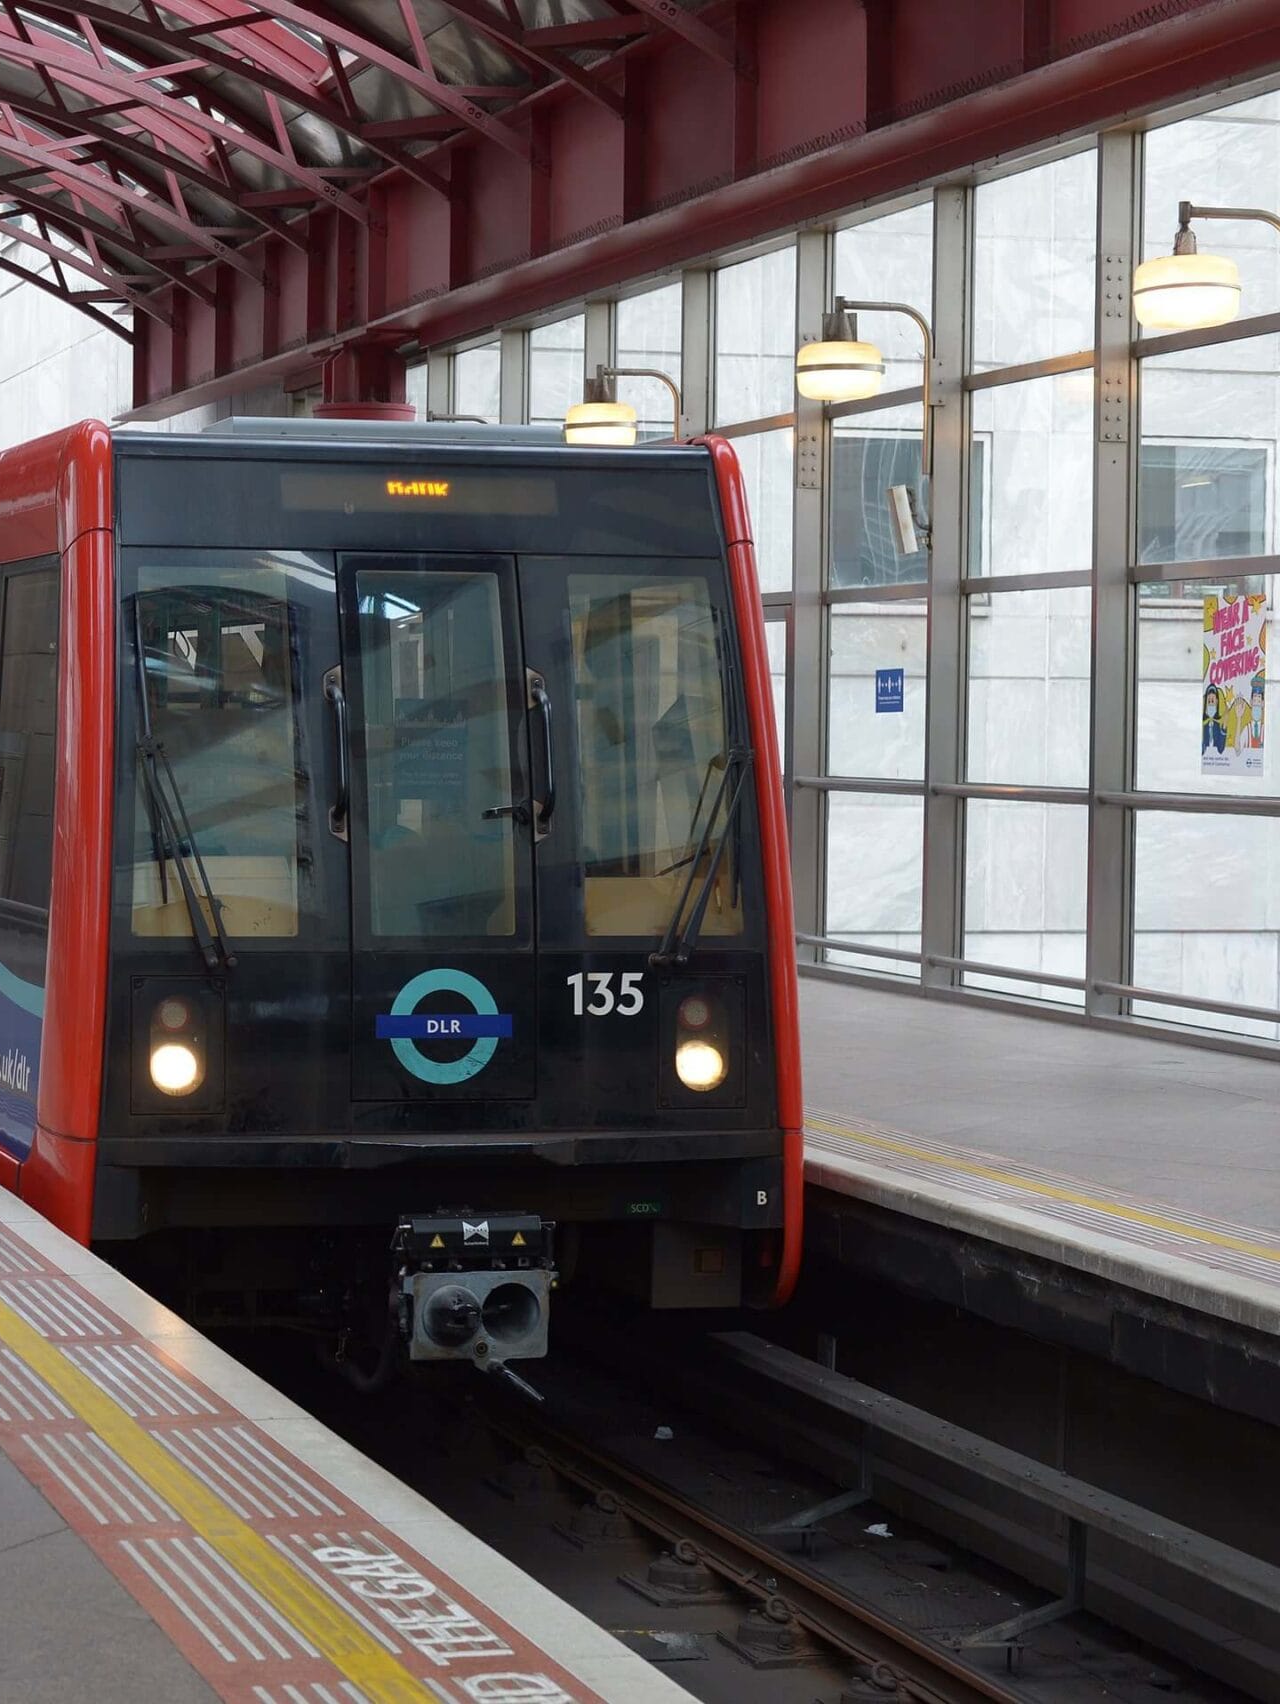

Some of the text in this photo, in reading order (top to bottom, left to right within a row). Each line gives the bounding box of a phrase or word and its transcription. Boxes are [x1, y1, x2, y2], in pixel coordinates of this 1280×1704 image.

[1212, 602, 1241, 635] WEAR
[1220, 625, 1245, 657] FACE
[1209, 646, 1260, 685] COVERING
[566, 972, 645, 1017] 135
[426, 1019, 462, 1034] DLR
[756, 1190, 768, 1206] B
[310, 1546, 516, 1667] THE GAP
